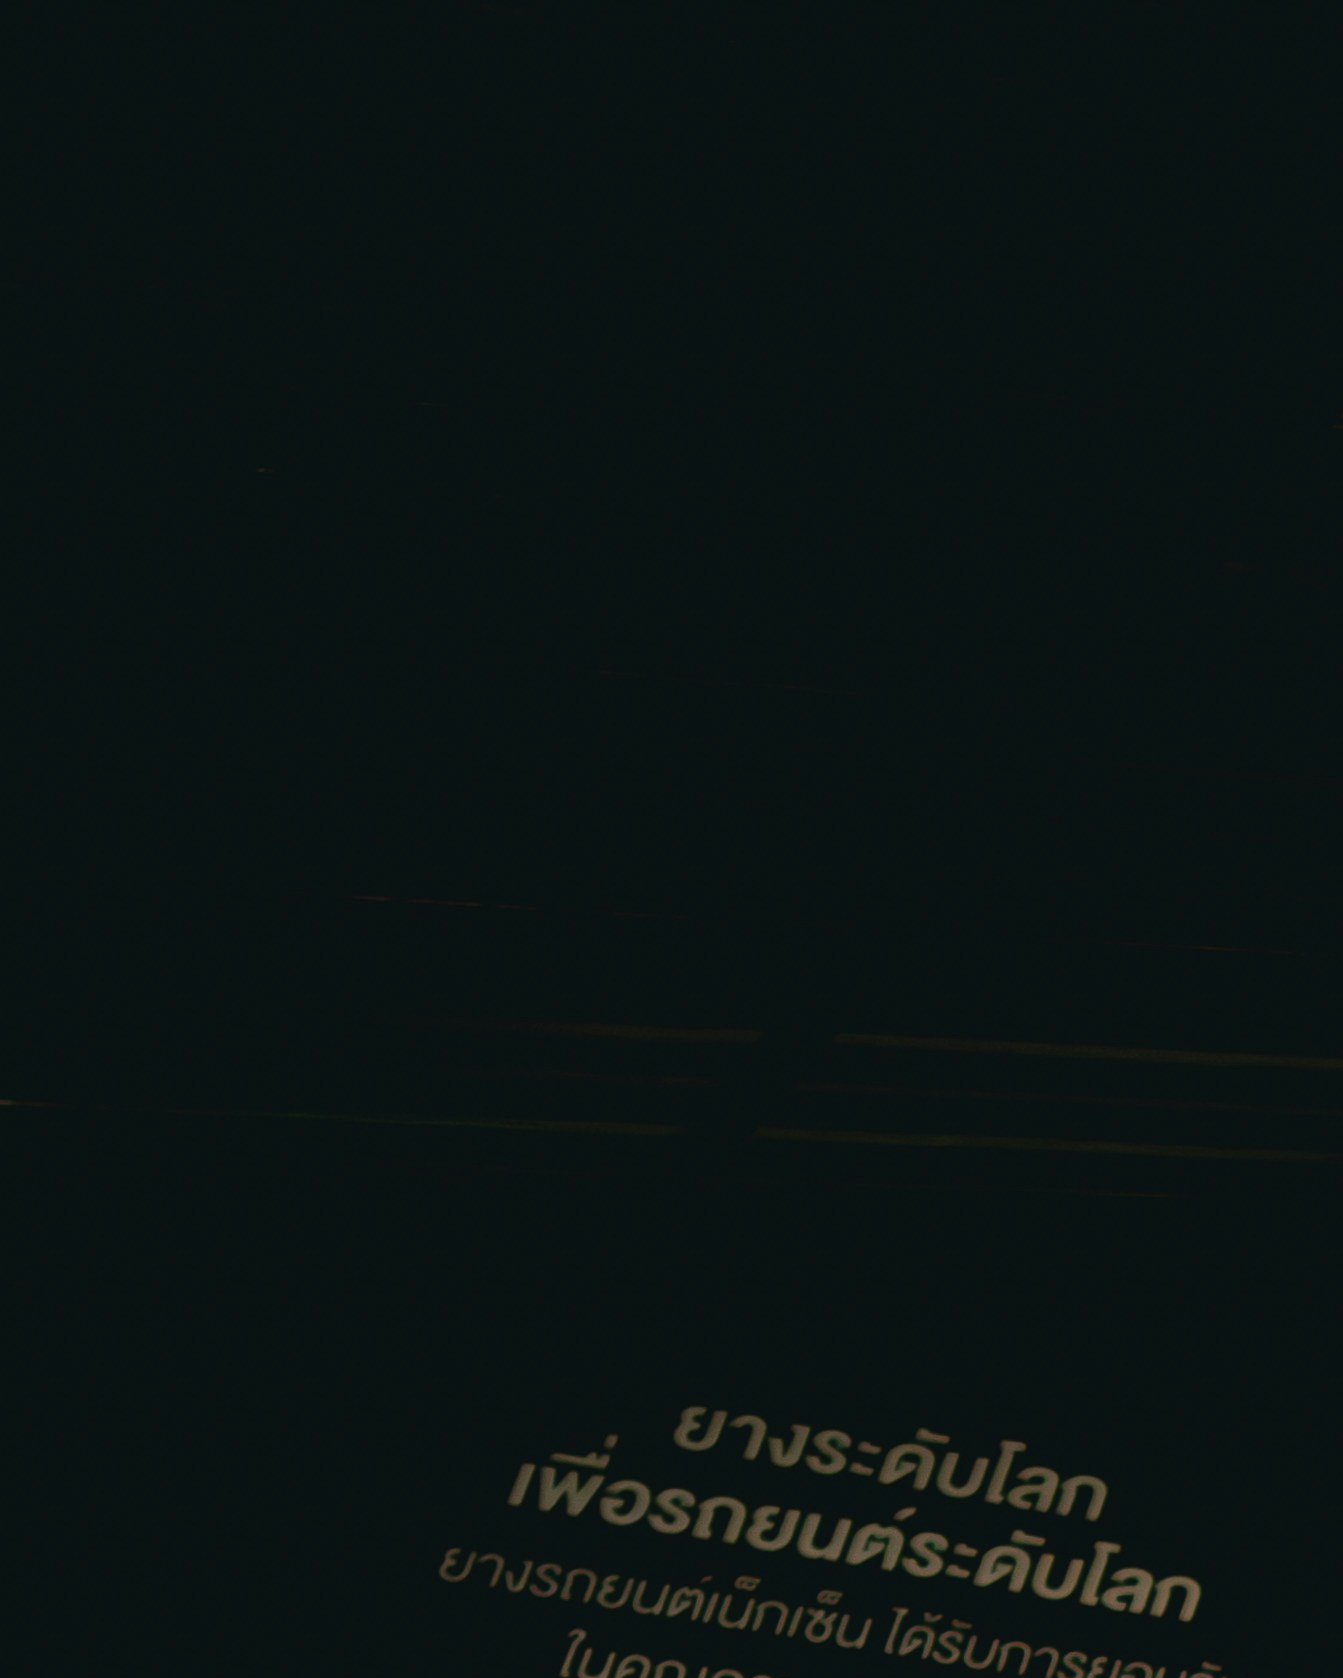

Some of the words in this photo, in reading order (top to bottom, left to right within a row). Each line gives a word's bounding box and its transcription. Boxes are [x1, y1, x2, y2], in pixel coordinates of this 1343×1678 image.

[674, 1405, 1108, 1521] ยางระดับโลก
[508, 1434, 1203, 1621] เพื่อรถยนต์ระดับโลก
[438, 1545, 872, 1649] ยางรถยนต์เน็กเซ็น
